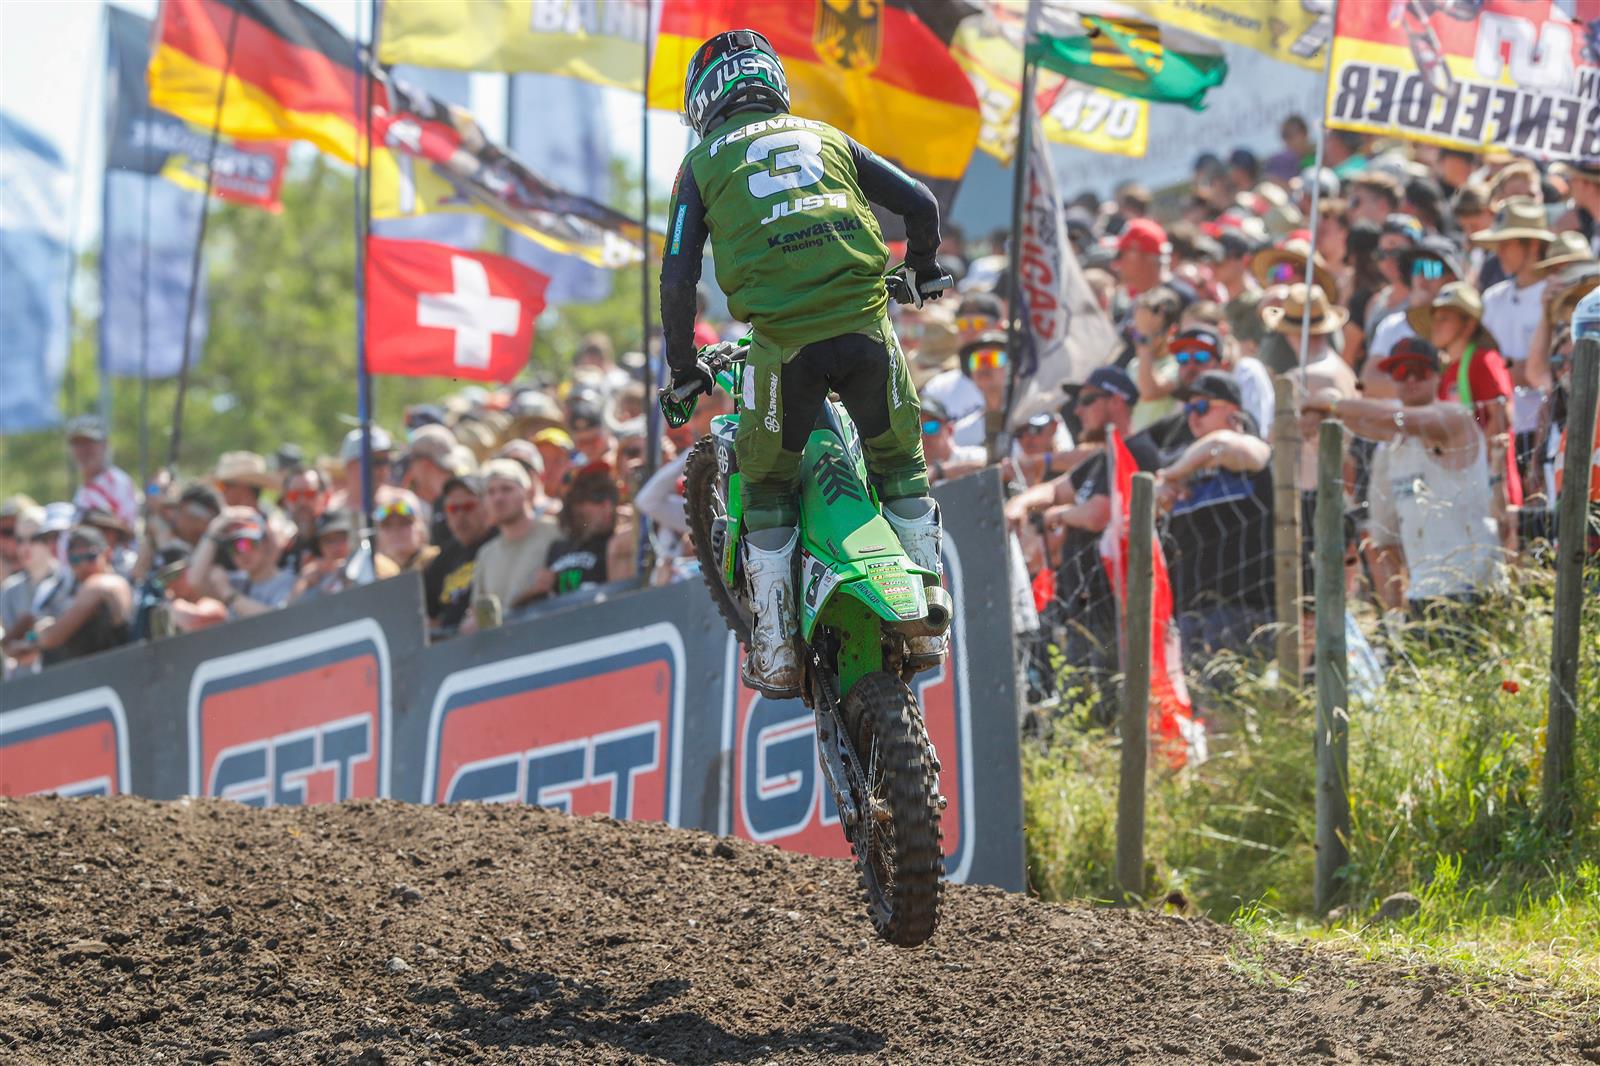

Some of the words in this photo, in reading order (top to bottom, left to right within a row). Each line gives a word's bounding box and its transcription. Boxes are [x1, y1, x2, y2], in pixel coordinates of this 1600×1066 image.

[1052, 90, 1139, 139] 470
[745, 130, 825, 198] 3
[767, 217, 863, 248] Kawasaki
[782, 238, 824, 254] Racing
[825, 232, 855, 243] Team
[856, 583, 881, 605] DUNLOP
